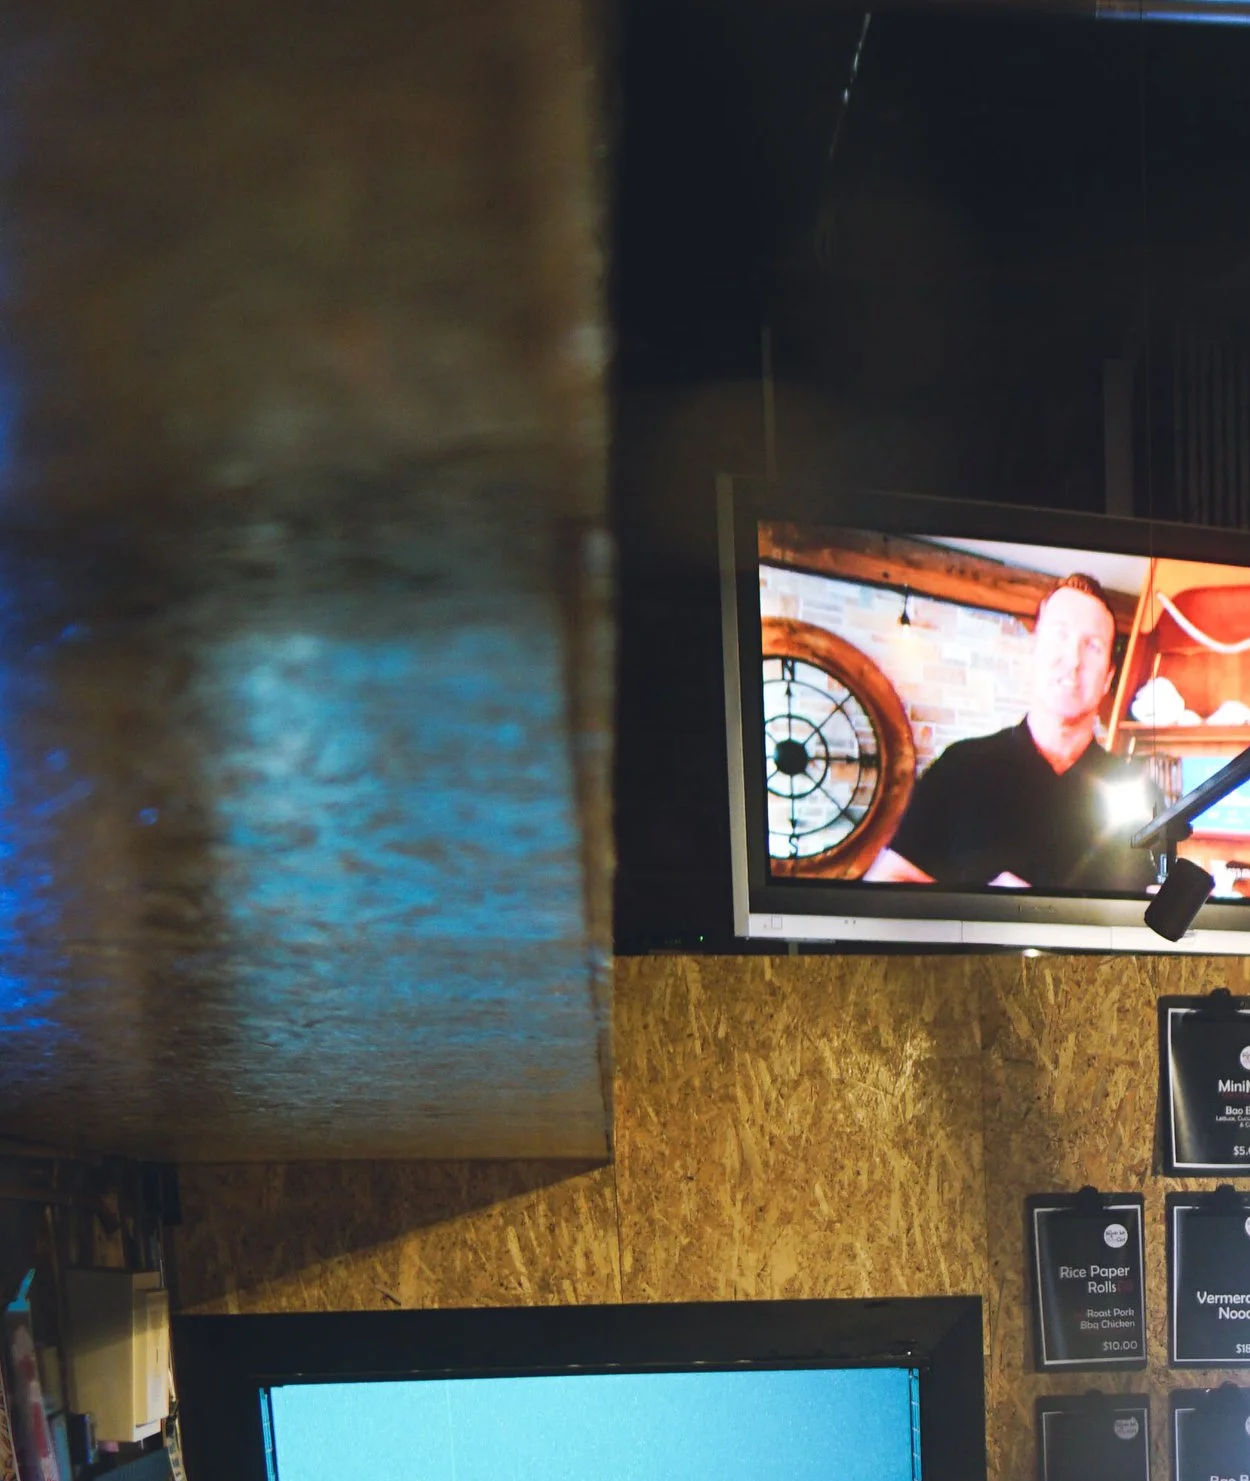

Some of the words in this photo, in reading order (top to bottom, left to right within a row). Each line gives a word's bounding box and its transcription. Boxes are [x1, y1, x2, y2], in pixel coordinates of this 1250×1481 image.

[1225, 1106, 1243, 1115] Bao
[1060, 1266, 1087, 1279] Rice
[1090, 1265, 1130, 1279] Paper
[1088, 1281, 1117, 1293] Rolls
[1087, 1308, 1111, 1318] Roast
[1113, 1307, 1134, 1317] Pork
[1080, 1320, 1099, 1330] Bbq
[1101, 1319, 1135, 1329] Chicken
[1103, 1341, 1138, 1351] $10.00
